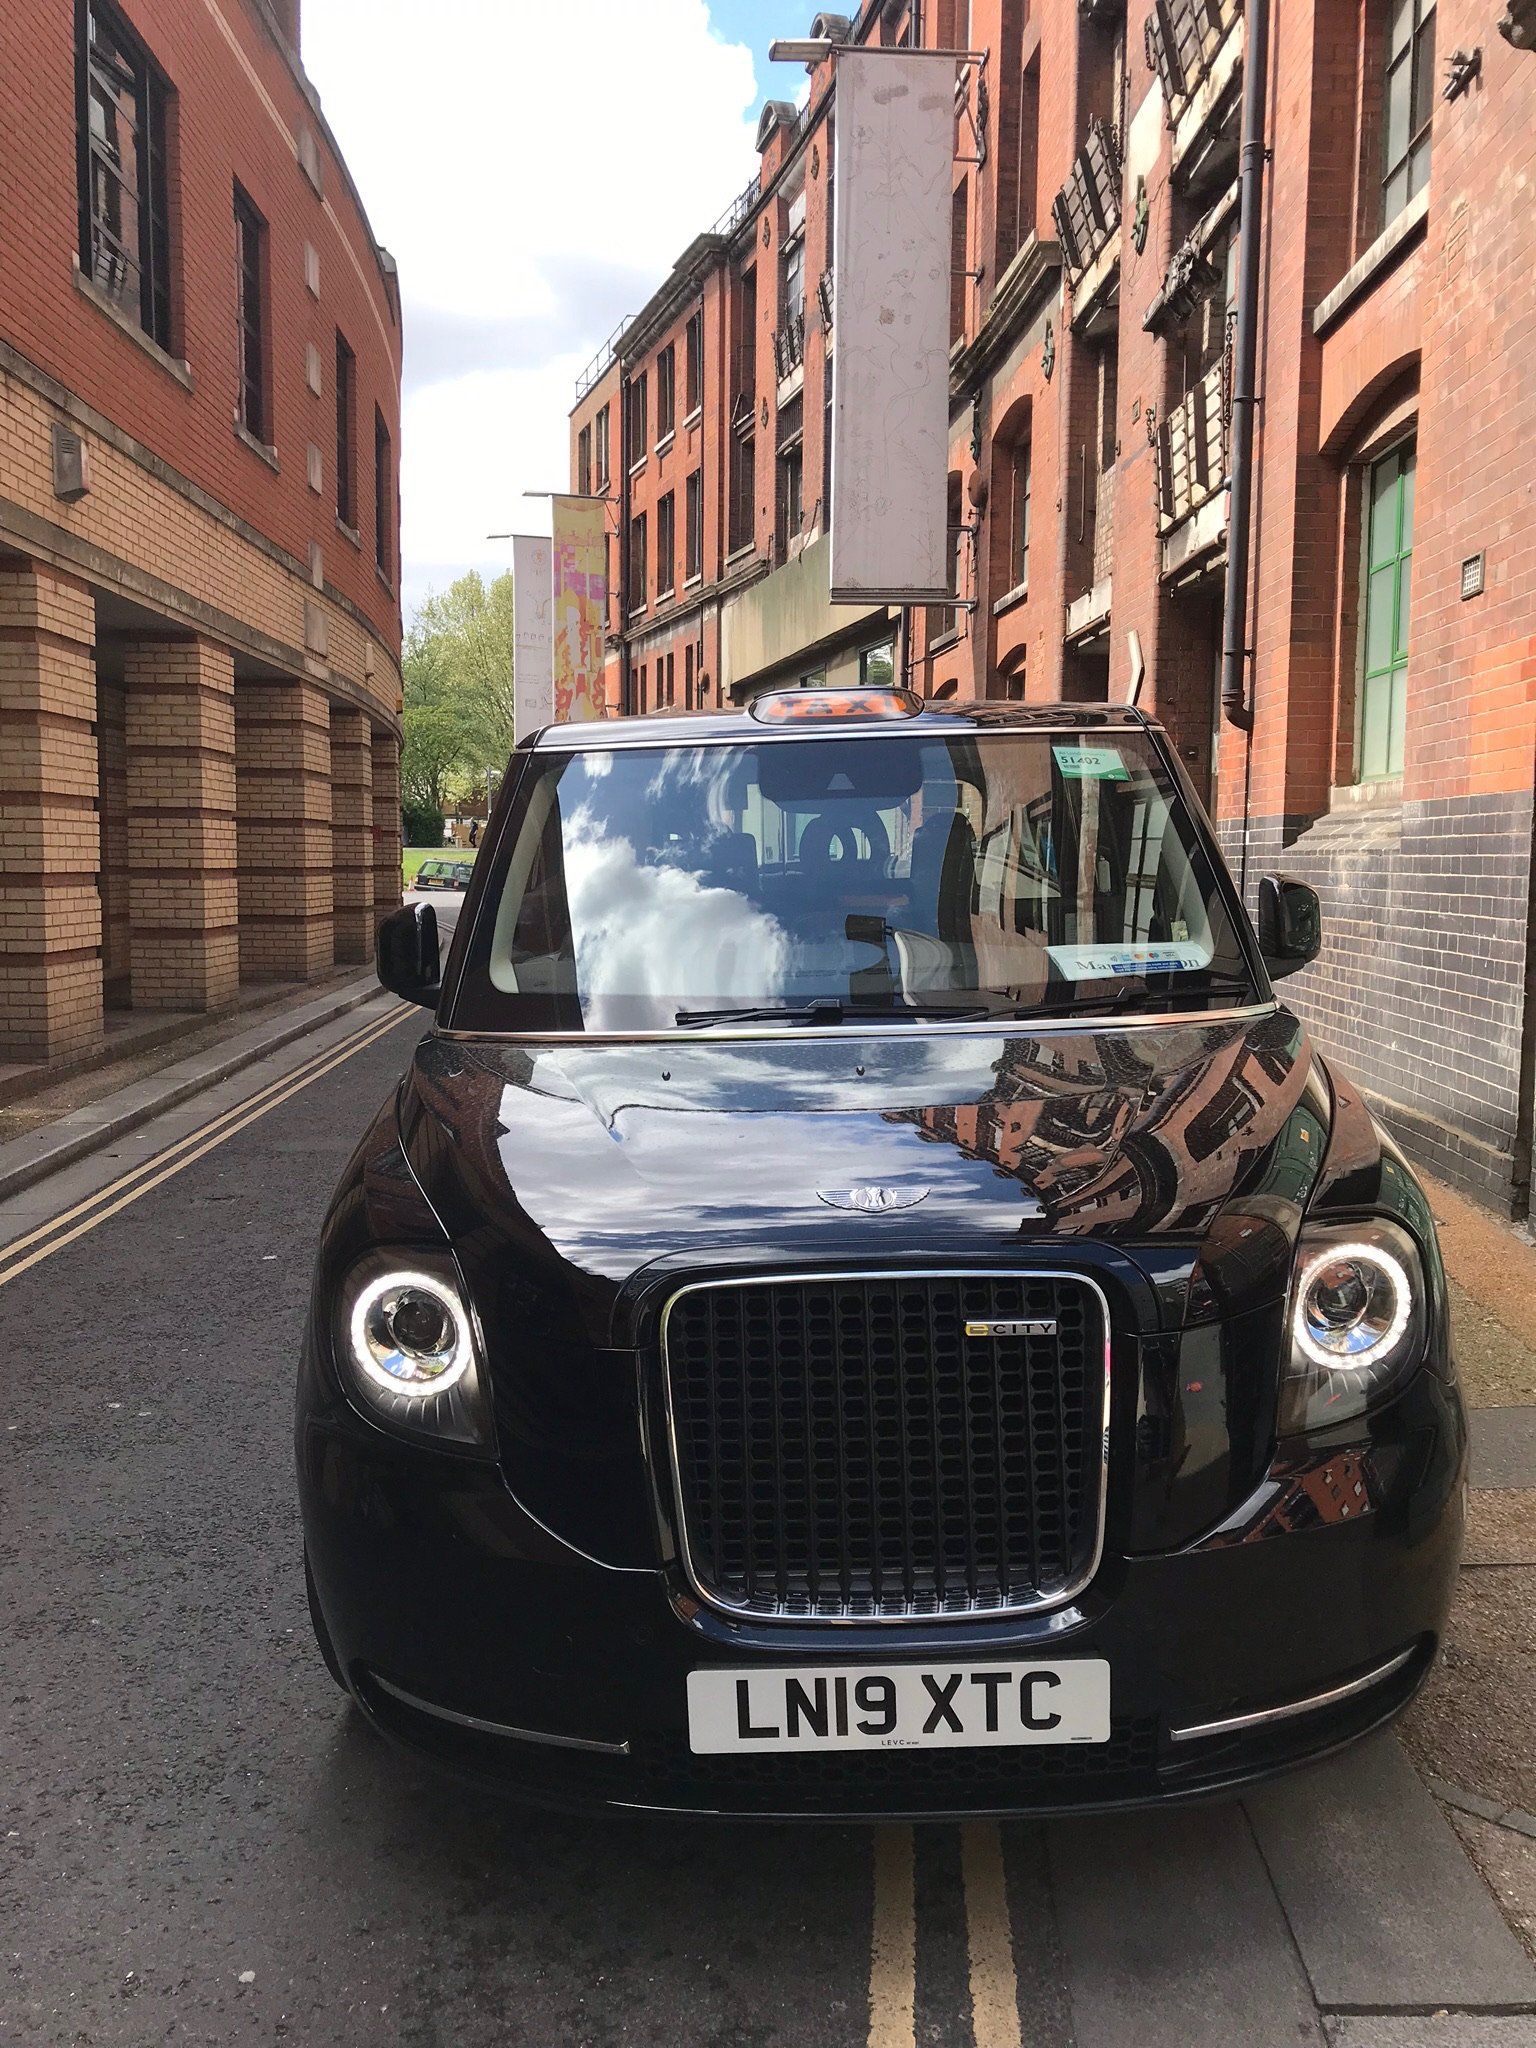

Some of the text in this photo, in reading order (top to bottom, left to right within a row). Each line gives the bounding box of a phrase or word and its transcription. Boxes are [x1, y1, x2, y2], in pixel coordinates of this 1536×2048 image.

[780, 698, 892, 715] TAXI
[736, 1671, 1062, 1739] LN19 XTC
